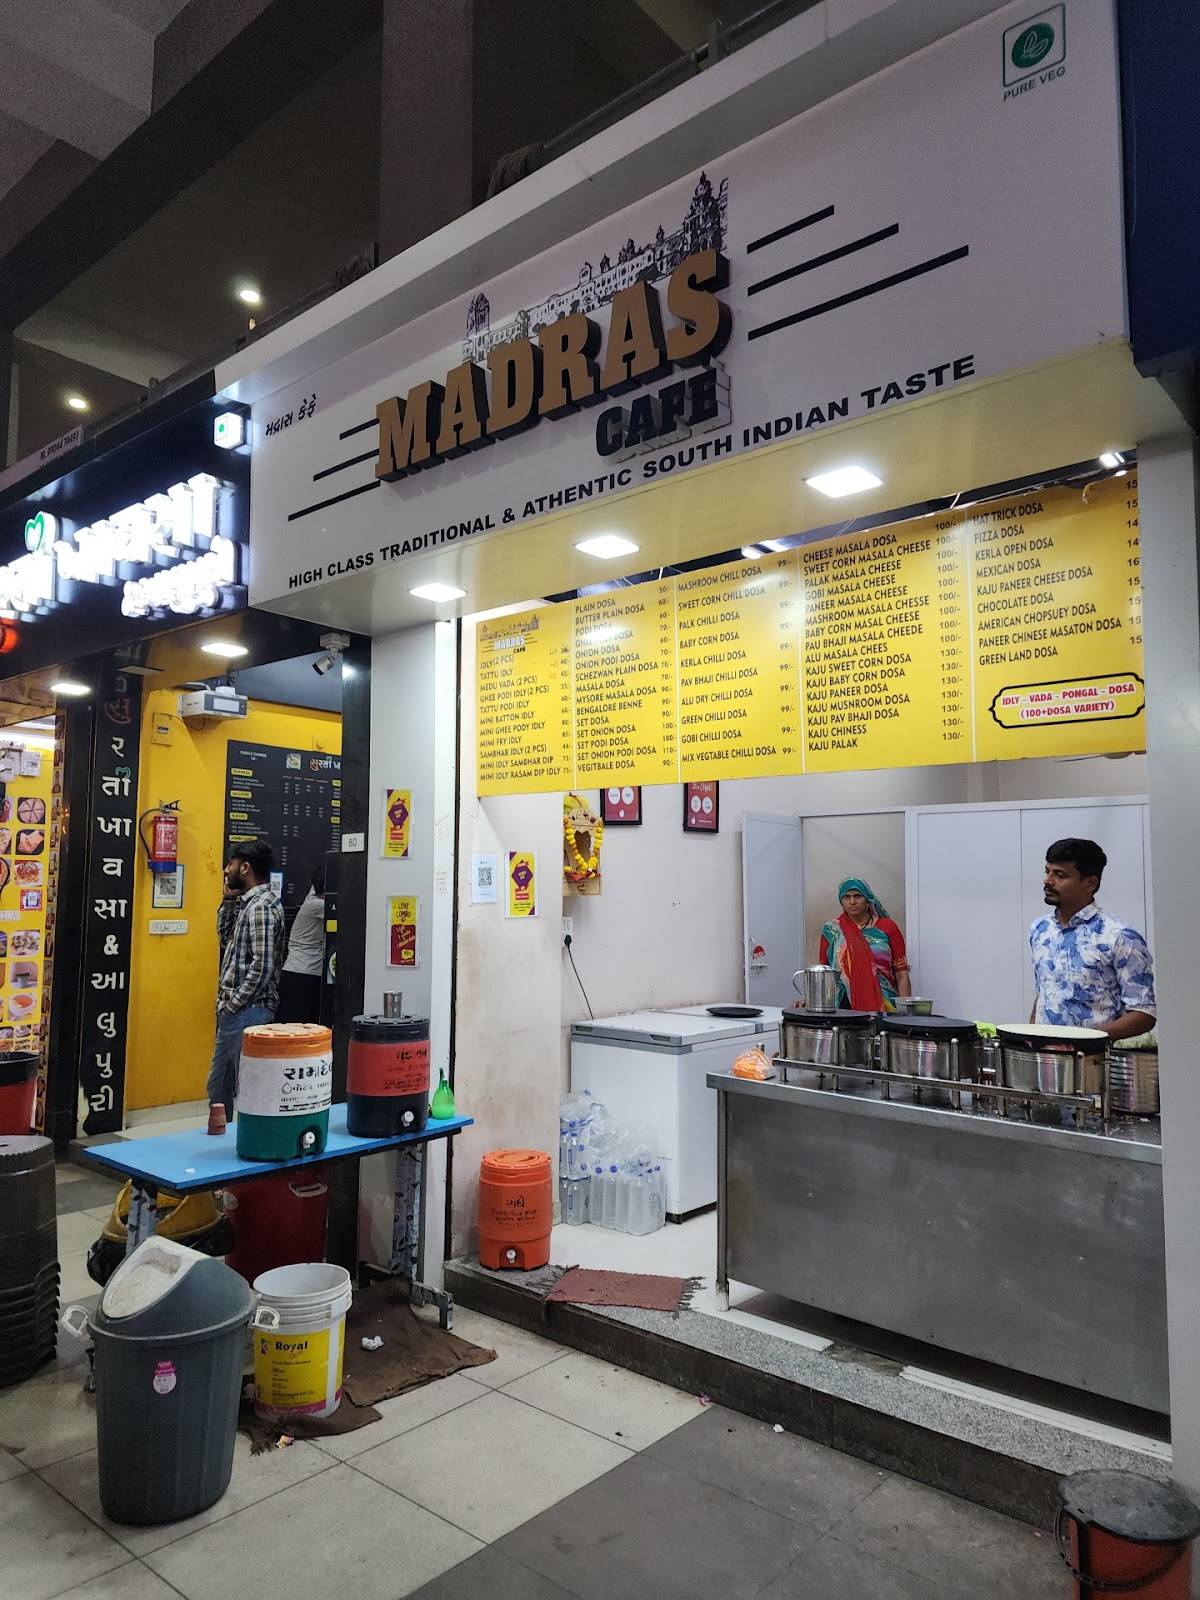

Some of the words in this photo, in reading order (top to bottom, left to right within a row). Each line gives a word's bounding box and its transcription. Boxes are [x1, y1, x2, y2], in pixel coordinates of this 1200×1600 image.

[1004, 78, 1036, 102] PURE
[1040, 66, 1065, 84] VEG
[375, 248, 729, 482] MADRAS
[596, 367, 719, 457] CAFE
[289, 567, 322, 589] HIGH
[328, 552, 374, 577] CLASS
[379, 515, 495, 560] TRADITIONAL
[502, 508, 515, 524] &
[522, 468, 632, 518] ATHENTIC
[643, 435, 732, 478] SOUTH
[743, 397, 848, 447] INDIAN
[861, 354, 975, 409] TASTE
[990, 508, 1016, 522] TRICK
[1018, 503, 1043, 516] DOSA
[974, 530, 998, 544] PIZZA
[1000, 525, 1025, 539] DOSA
[803, 548, 833, 563] CHEESE
[835, 540, 870, 556] MASALA
[872, 535, 897, 549] DOSA
[804, 562, 829, 576] SWEET
[831, 556, 856, 570] CORN
[858, 548, 894, 565] MASALA
[896, 540, 930, 557] CHEESE
[975, 547, 1001, 561] KERLA
[1003, 542, 1027, 556] OPEN
[1029, 538, 1053, 551] DOSA
[804, 574, 829, 588] PALAK
[831, 567, 866, 583] MASALA
[868, 560, 901, 576] CHEESE
[976, 563, 1014, 579] MEXICAN
[1017, 558, 1041, 572] DOSA
[976, 582, 997, 596] KAJU
[999, 576, 1031, 592] PANEER
[1033, 570, 1065, 586] CHEESE
[1068, 566, 1093, 580] DOSA
[977, 596, 1027, 613] CHOCOLATE
[1030, 592, 1054, 605] DOSA
[575, 612, 600, 624] BUTTER
[602, 608, 623, 619] PLAIN
[624, 604, 645, 615] DOSA
[696, 615, 718, 628] CHILLI
[720, 612, 740, 623] DOSA
[978, 615, 1021, 631] AMERICAN
[1023, 608, 1068, 624] CHOPSUEY
[1071, 604, 1096, 616] DOSA
[805, 640, 820, 650] PAU
[823, 636, 846, 648] BHAJI
[849, 630, 884, 644] MASALA
[978, 634, 1009, 648] PANEER
[1012, 629, 1047, 643] CHINESE
[1095, 618, 1121, 631] DOSA
[680, 656, 702, 669] KERLA
[703, 653, 725, 665] CHILLI
[726, 650, 746, 662] DOSA
[805, 664, 826, 676] KAJU
[828, 661, 855, 673] SWEET
[858, 657, 883, 669] CORN
[886, 654, 911, 666] DOSA
[979, 653, 1006, 666] GREEN
[1008, 650, 1032, 662] LAND
[1034, 647, 1058, 659] DOSA
[615, 665, 636, 676] PLAIN
[638, 662, 659, 673] DOSA
[681, 677, 692, 687] PAV
[694, 674, 714, 685] BHAJI
[715, 671, 737, 683] CHILLI
[738, 668, 758, 679] DOSA
[806, 677, 827, 688] KAJU
[829, 674, 849, 686] BABY
[852, 671, 878, 683] CORN
[880, 668, 905, 680] DOSA
[806, 690, 827, 700] KAJU
[829, 687, 861, 698] PANEER
[863, 684, 888, 695] DOSA
[1003, 696, 1020, 705] IDLY
[1029, 693, 1053, 702] VADA
[1062, 688, 1098, 699] PONGAL
[1108, 683, 1135, 694] DOSA
[576, 703, 616, 716] BENGALORE
[618, 700, 642, 711] BENNE
[807, 702, 827, 713] KAJU
[884, 694, 910, 706] DOSA
[1021, 707, 1071, 719] (100+DOSA
[1074, 701, 1115, 713] VARIETY)
[681, 714, 703, 725] GREEN
[704, 711, 726, 722] CHILLI
[727, 709, 747, 720] DOSA
[807, 714, 828, 726] KAJU
[830, 713, 845, 724] PAV
[847, 711, 872, 722] BHAJI
[874, 709, 899, 720] DOSA
[576, 729, 588, 738] SET
[590, 727, 614, 737] ONION
[616, 725, 636, 734] DOSA
[681, 734, 698, 744] GOBI
[699, 732, 720, 742] CHILLI
[722, 730, 742, 740] DOSA
[808, 728, 828, 738] KAJU
[831, 725, 866, 736] CHINESS
[681, 752, 694, 762] MIX
[731, 748, 754, 758] CHILLI
[755, 746, 776, 757] DOSA
[808, 741, 829, 751] KAJU
[831, 739, 857, 750] PALAK
[615, 760, 635, 769] DOSA
[103, 935, 119, 955] &
[275, 1341, 308, 1352] Royal
